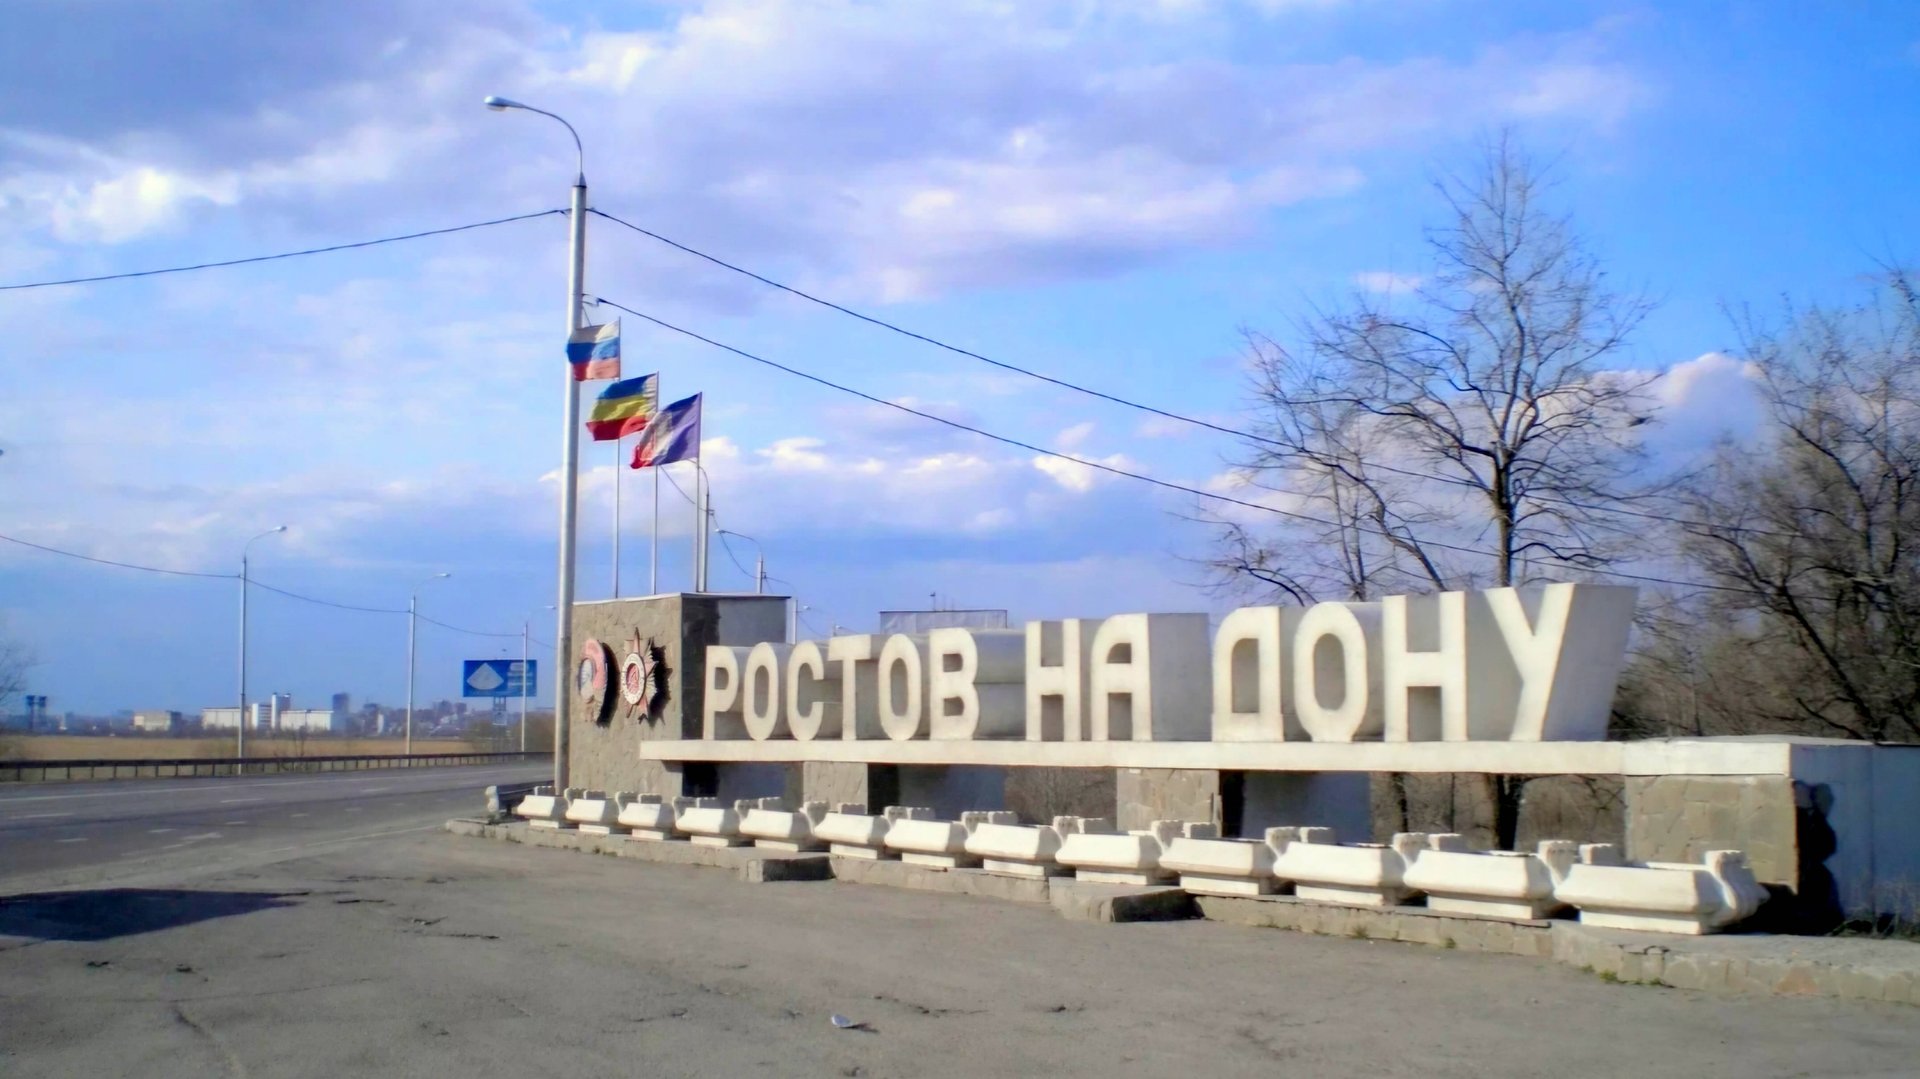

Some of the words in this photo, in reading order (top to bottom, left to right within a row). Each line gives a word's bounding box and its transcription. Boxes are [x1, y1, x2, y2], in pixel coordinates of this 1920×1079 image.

[704, 628, 979, 741] РОСТОВ
[1025, 613, 1151, 742] НА
[1212, 582, 1575, 742] ДОНУ
